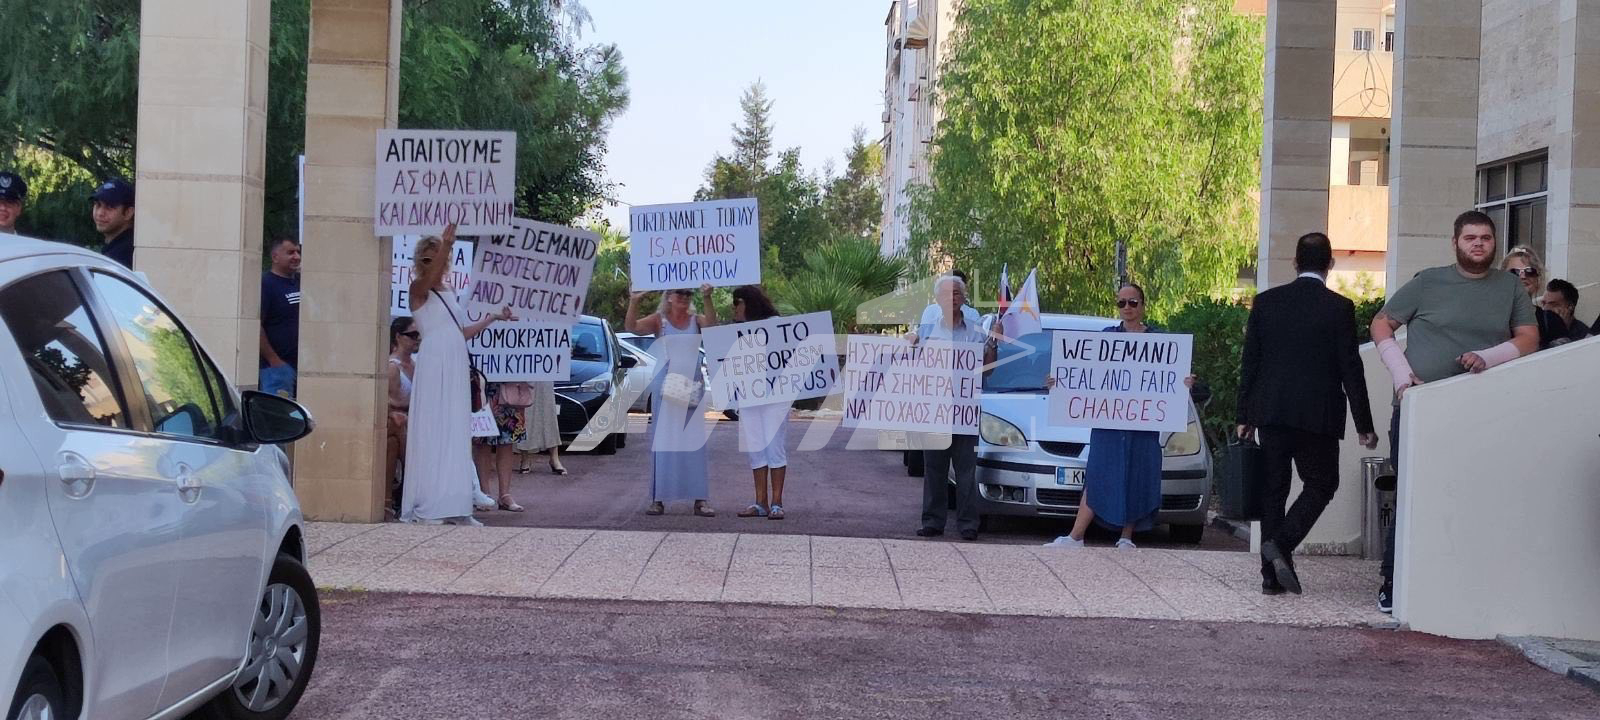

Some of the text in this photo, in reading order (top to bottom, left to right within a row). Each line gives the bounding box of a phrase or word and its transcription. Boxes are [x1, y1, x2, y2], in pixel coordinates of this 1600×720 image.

[386, 138, 502, 163] ΑΠΑΙΤΟΥΜΕ
[392, 169, 496, 194] ΑΣΦΑΛΕΙΑ
[380, 202, 404, 226] ΚΑΙ
[717, 207, 755, 227] TODAY
[522, 228, 596, 260] DEMAND
[649, 234, 735, 258] IS A CHAOS
[481, 250, 580, 287] PROTECTION
[648, 259, 738, 283] TOMORROW
[471, 280, 504, 305] AND
[471, 328, 570, 348] ΡΟΜΟΚΡΑΤΙΑ
[737, 321, 809, 350] NO TO
[717, 344, 825, 377] TERRORISM
[1062, 338, 1179, 364] WE DEMAND
[726, 380, 747, 402] IN
[847, 369, 886, 393] ΤΗΤΑ
[891, 372, 954, 398] ΣΗΜΕΡΑ
[1055, 366, 1177, 394] REAL AND FAIR
[847, 398, 872, 420] ΝΑΙ
[875, 400, 895, 422] ΤΟ
[897, 401, 930, 424] ΧΑΟΣ
[1068, 397, 1167, 422] CHARGES
